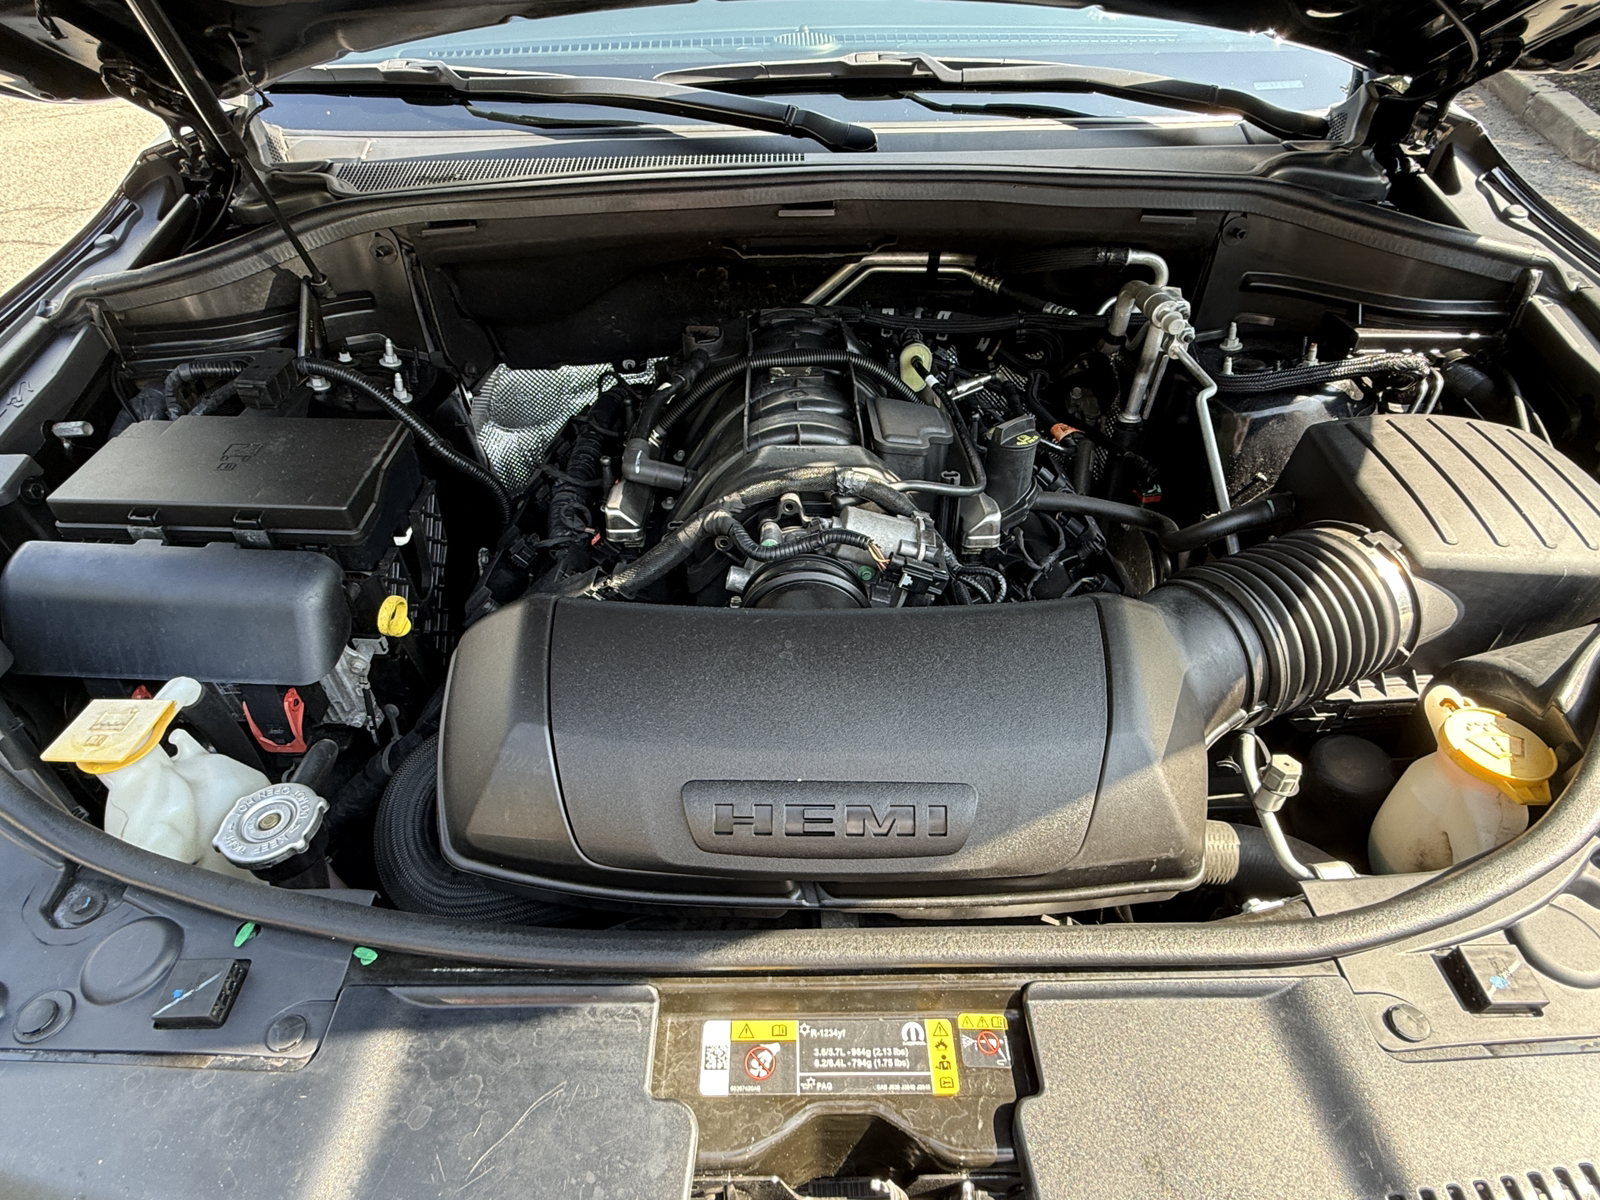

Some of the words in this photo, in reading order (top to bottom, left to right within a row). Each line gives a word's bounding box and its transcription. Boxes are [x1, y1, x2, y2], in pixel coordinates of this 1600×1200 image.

[258, 786, 291, 799] OPEN
[233, 798, 256, 817] HOT
[713, 803, 948, 837] HEMI
[872, 1047, 892, 1058] (2.13
